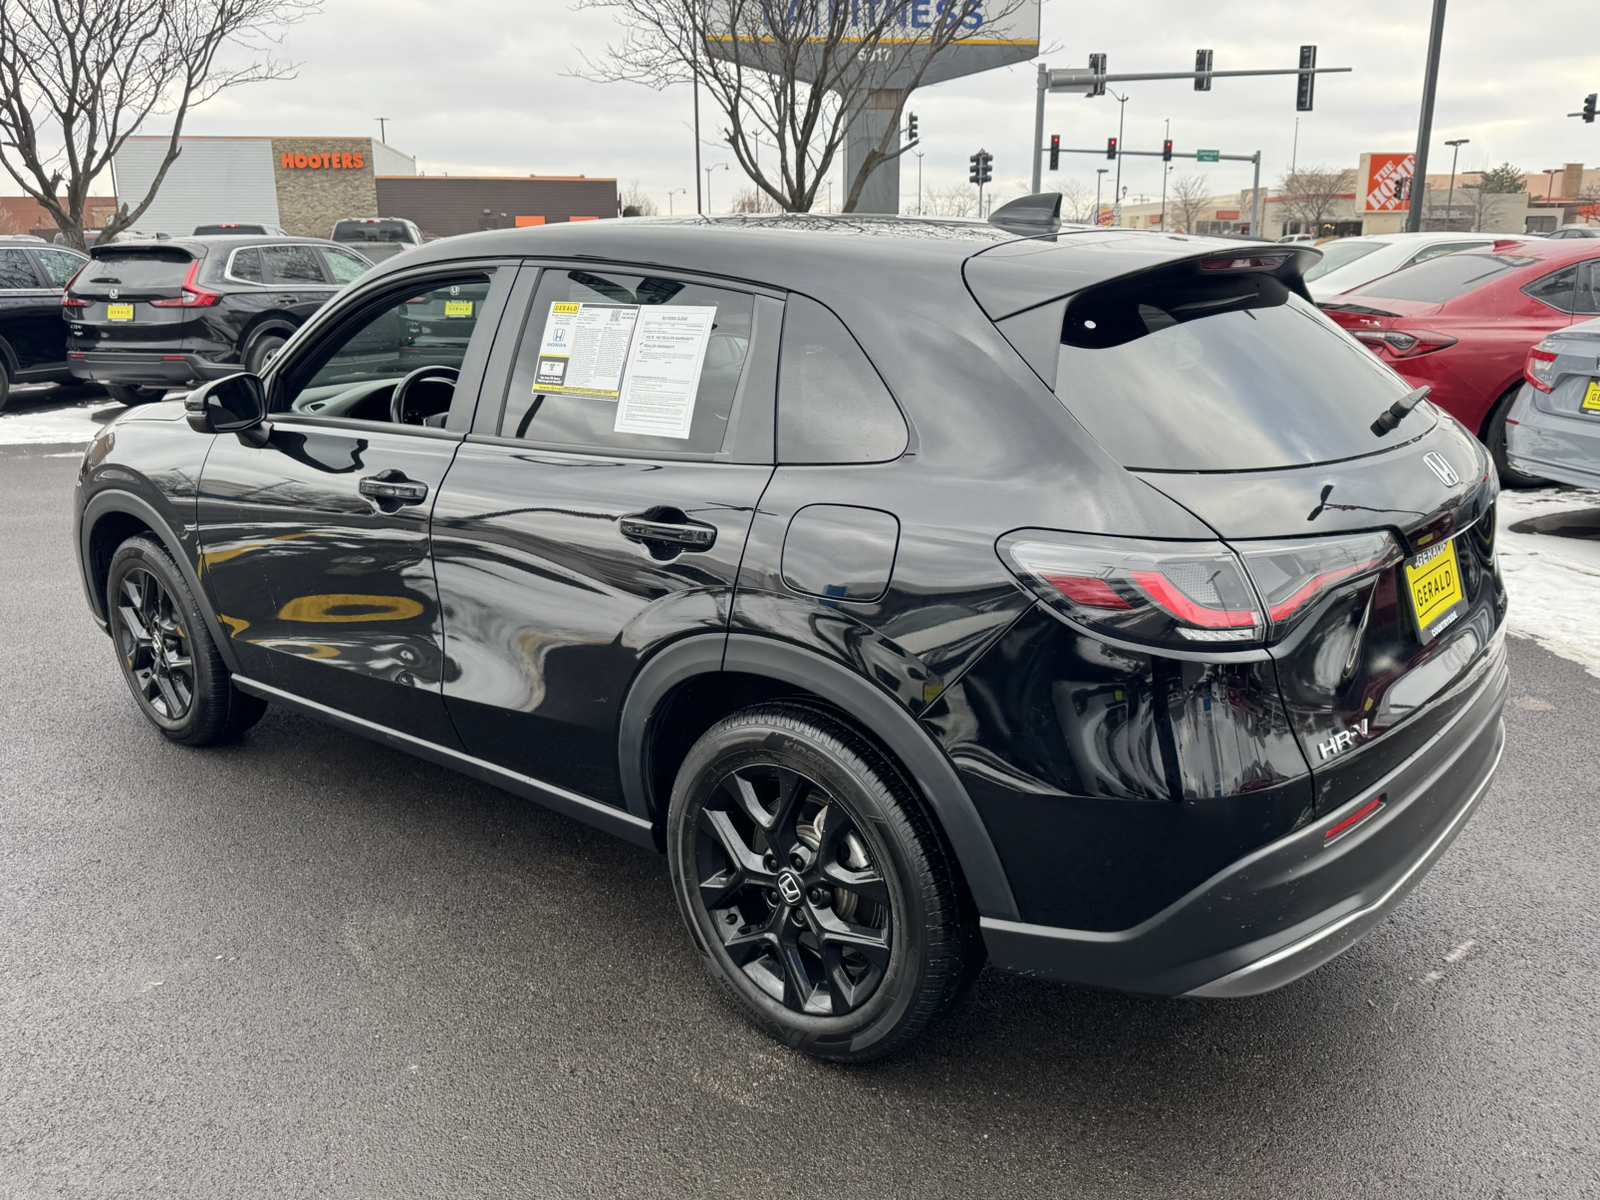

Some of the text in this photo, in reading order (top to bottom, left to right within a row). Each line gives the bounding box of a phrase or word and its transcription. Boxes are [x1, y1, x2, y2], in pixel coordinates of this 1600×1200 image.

[281, 153, 364, 169] HOOTERS
[1374, 160, 1397, 183] THE
[1367, 155, 1416, 210] HOME
[554, 304, 578, 312] GERALD
[1417, 570, 1452, 607] GERALD
[1431, 610, 1458, 637] COUNTRYSIDE
[1318, 718, 1368, 759] HR-V
